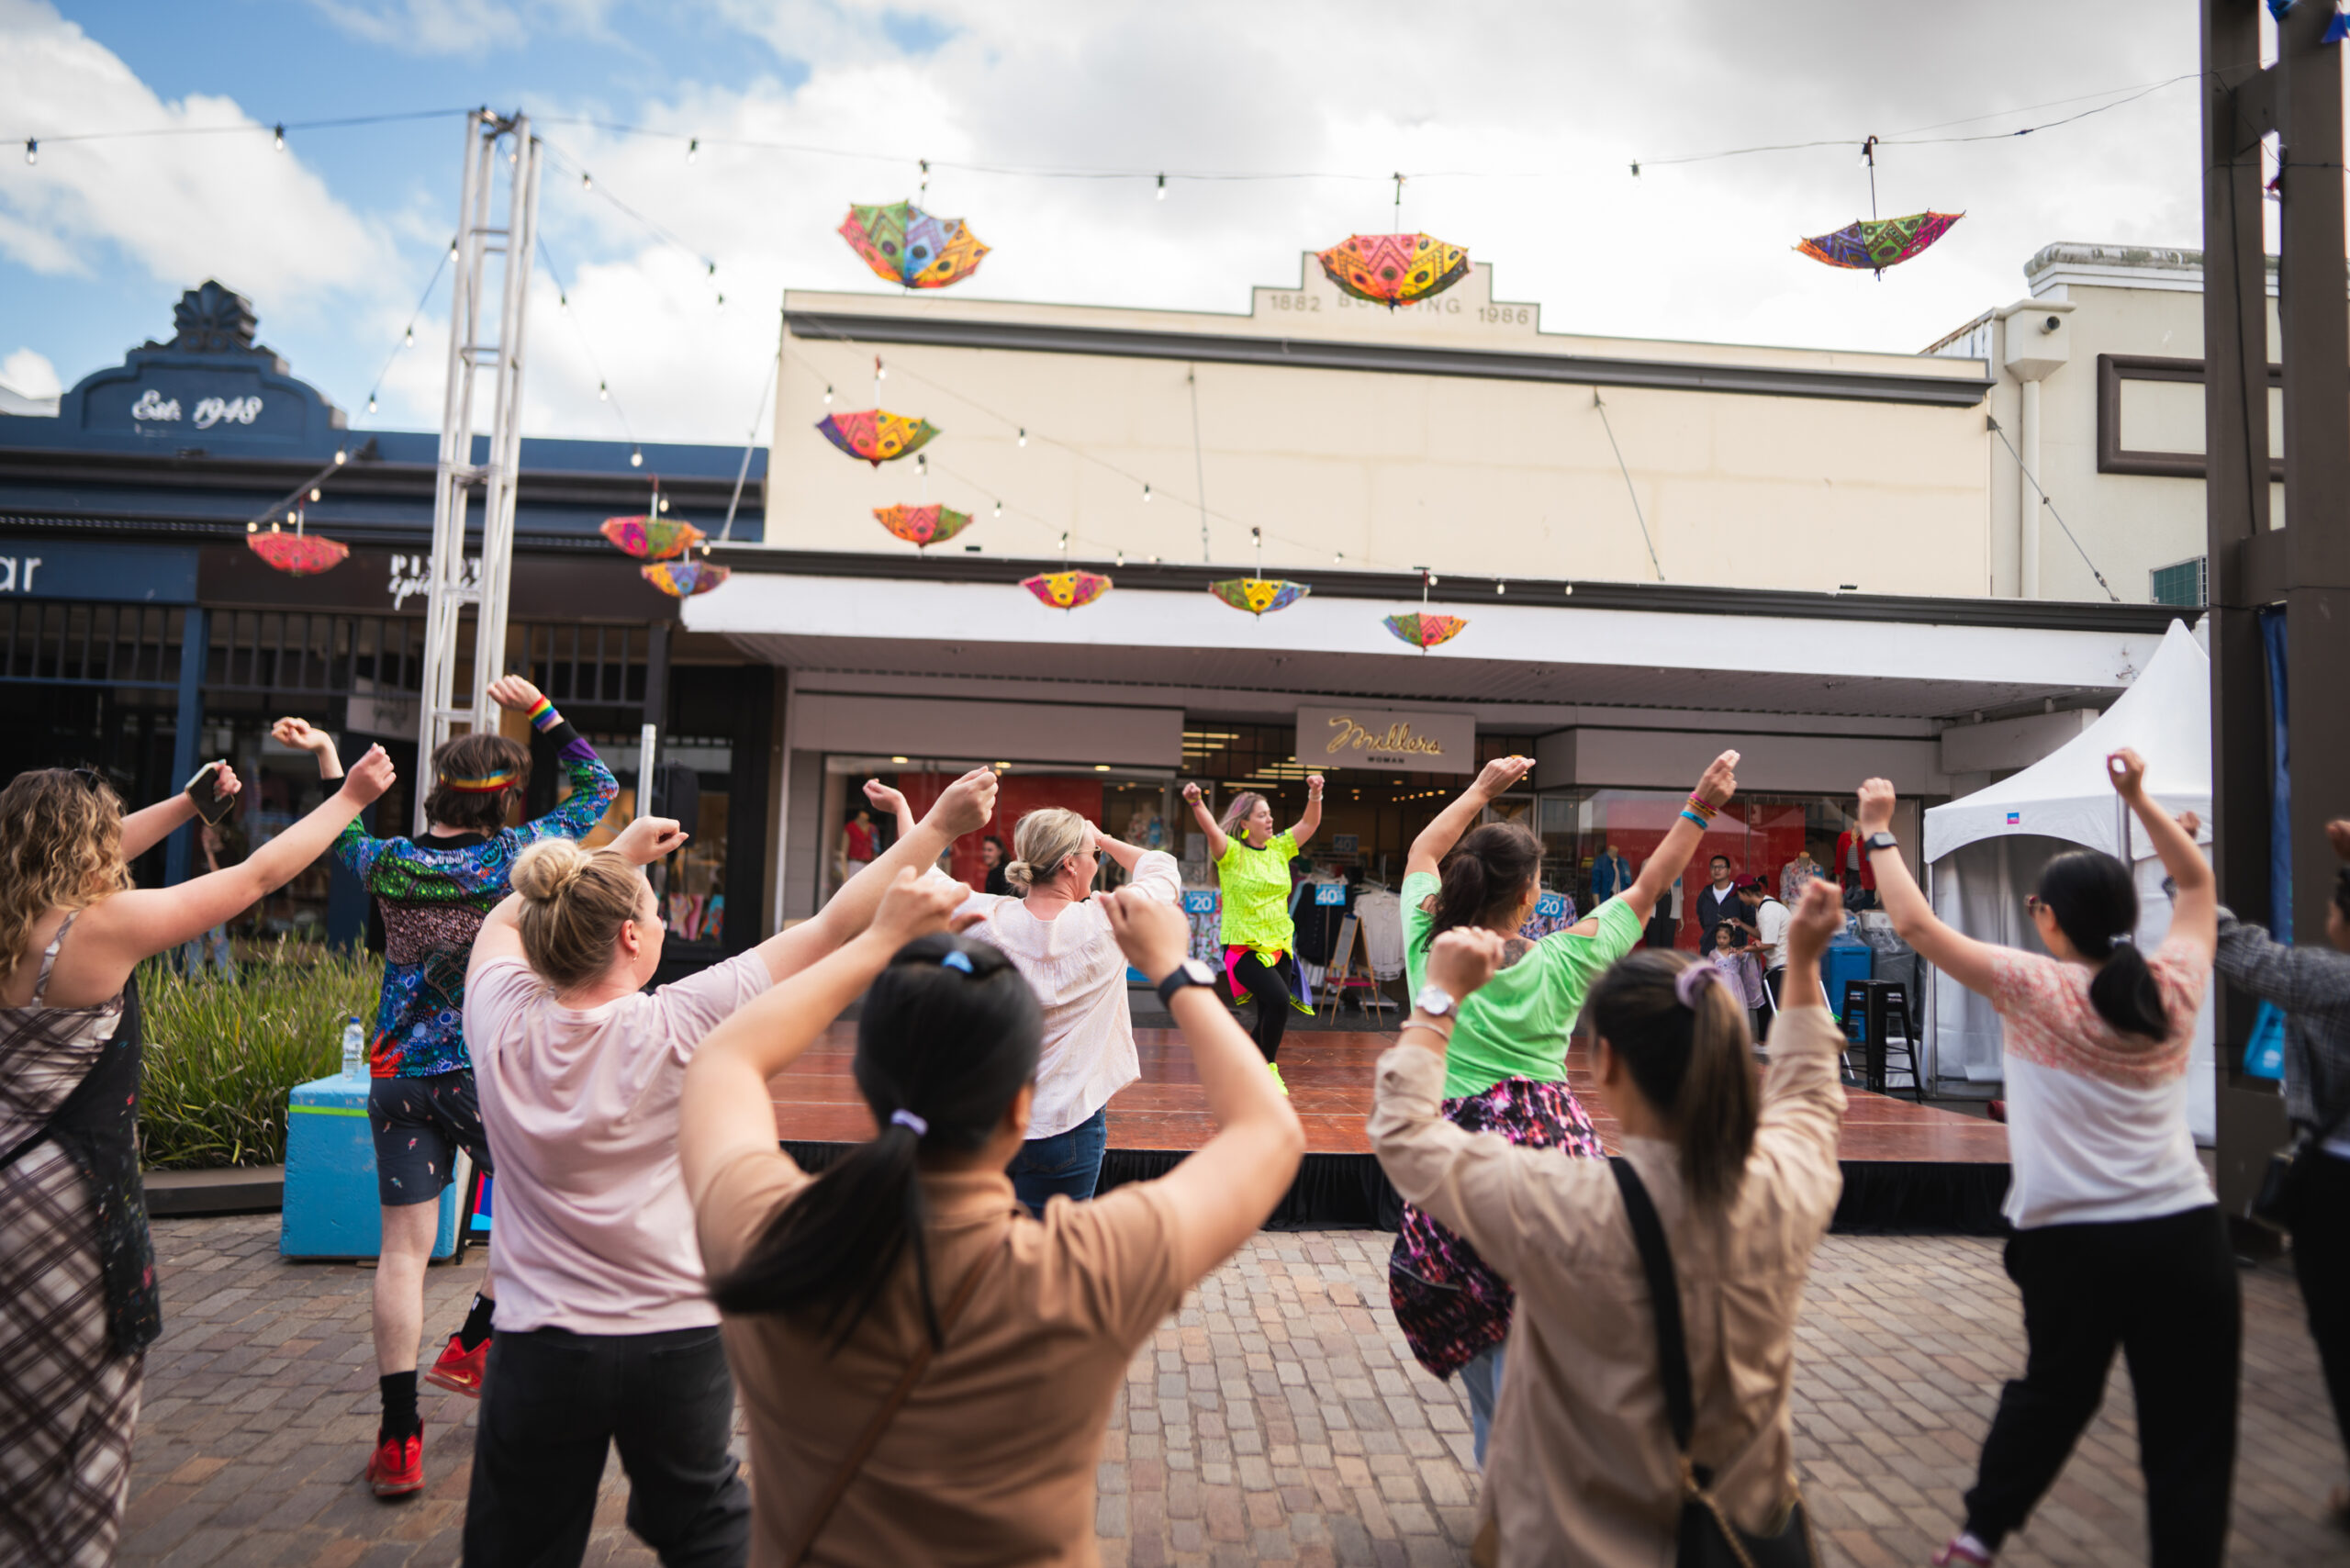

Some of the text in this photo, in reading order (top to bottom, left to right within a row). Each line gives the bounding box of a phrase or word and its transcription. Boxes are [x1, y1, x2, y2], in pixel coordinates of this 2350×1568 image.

[1270, 295, 1322, 312] 1882
[1477, 307, 1529, 325] 1986
[192, 396, 264, 430] 1948
[1326, 715, 1446, 756] Millers
[1367, 756, 1405, 765] WOMAN
